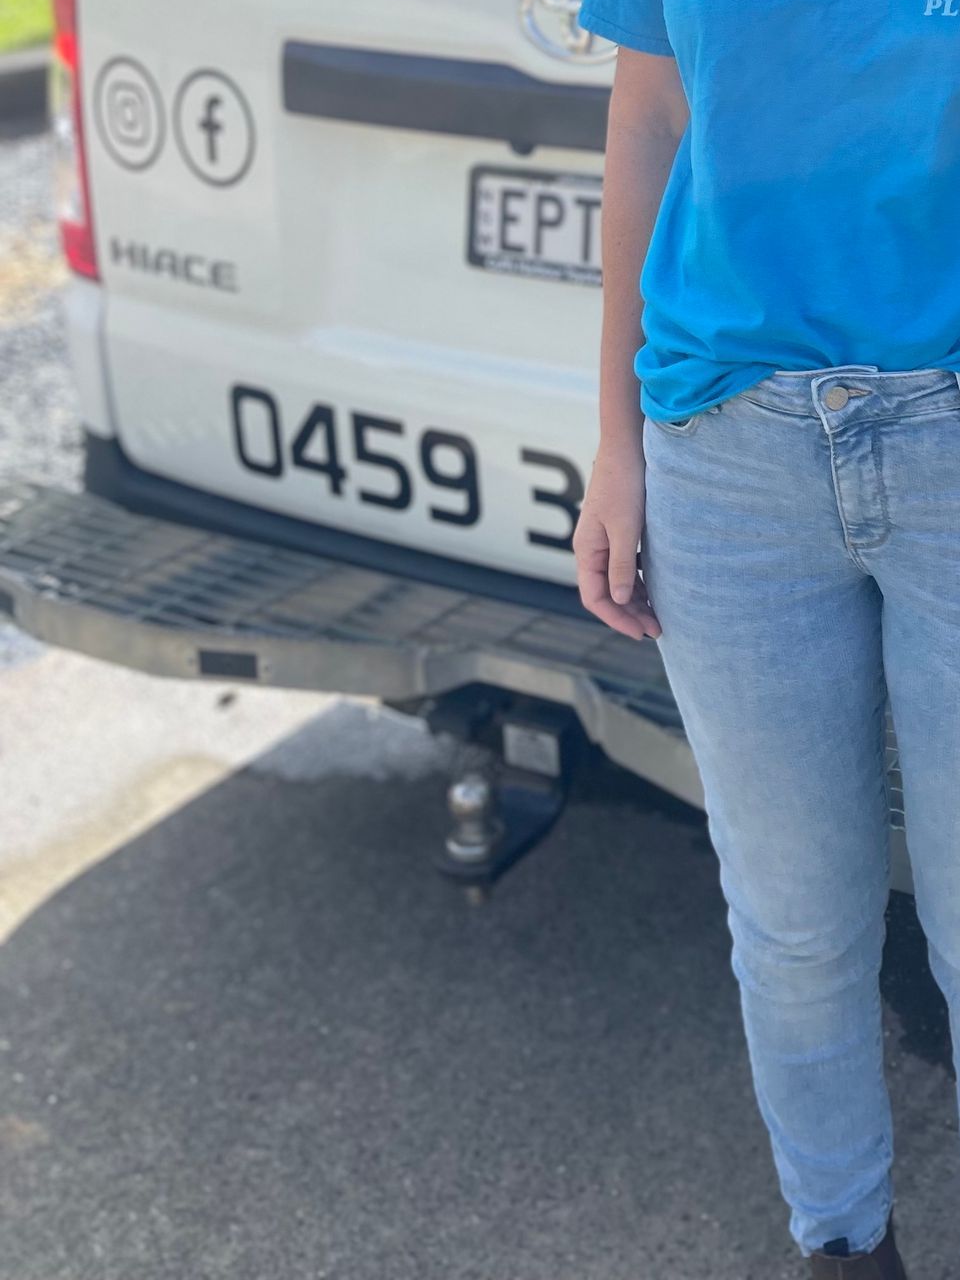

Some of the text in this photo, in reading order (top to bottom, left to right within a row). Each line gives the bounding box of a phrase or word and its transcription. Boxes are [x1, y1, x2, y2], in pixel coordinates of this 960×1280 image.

[501, 188, 602, 263] EPT
[109, 236, 241, 293] HIACE
[230, 384, 482, 527] 0459
